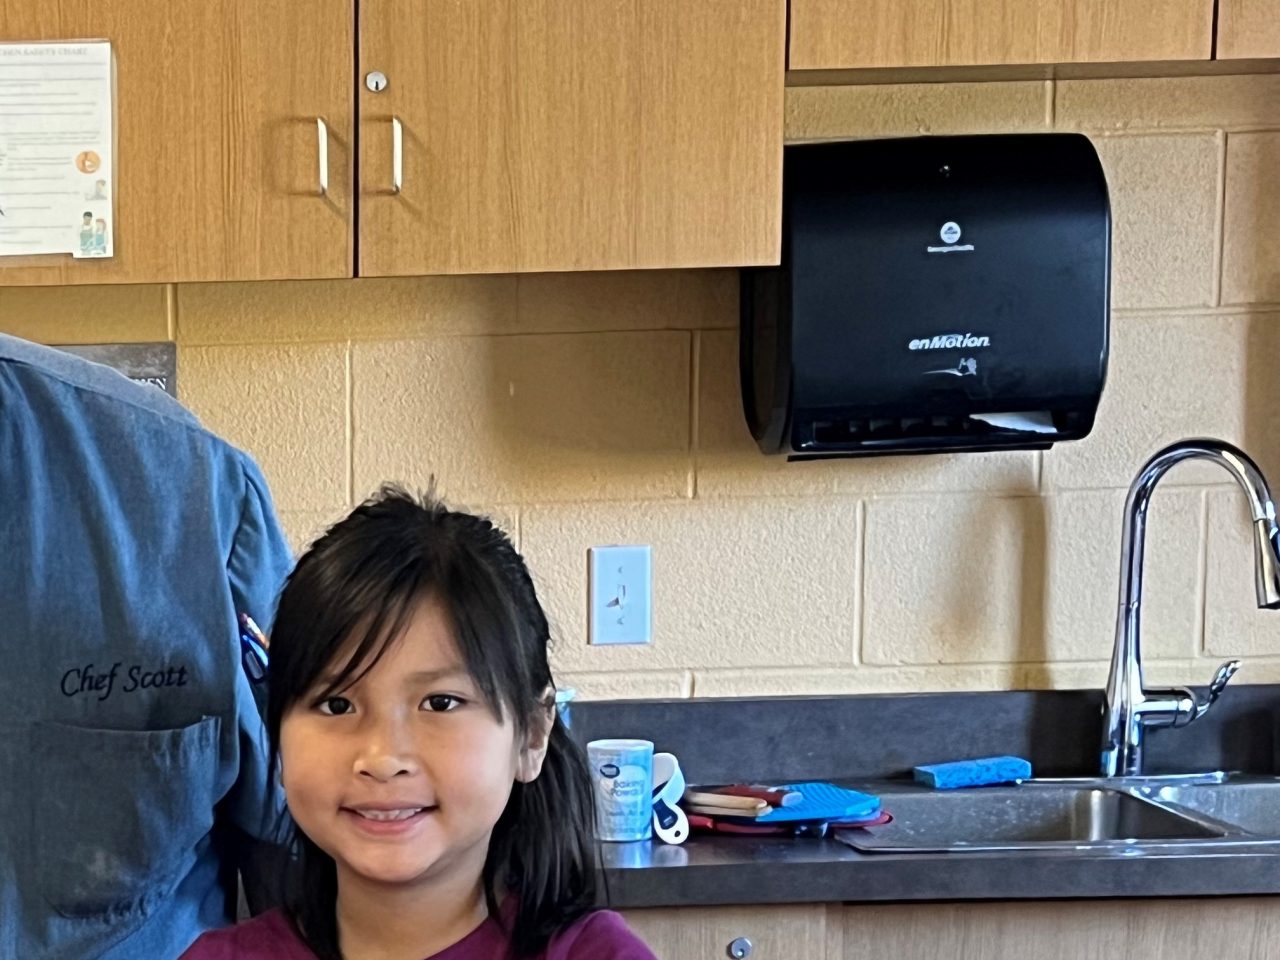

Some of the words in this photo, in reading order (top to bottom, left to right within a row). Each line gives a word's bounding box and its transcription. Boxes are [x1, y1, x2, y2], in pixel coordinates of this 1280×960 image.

[908, 332, 990, 351] enMotion
[60, 662, 122, 701] Chef
[123, 665, 188, 693] Scott
